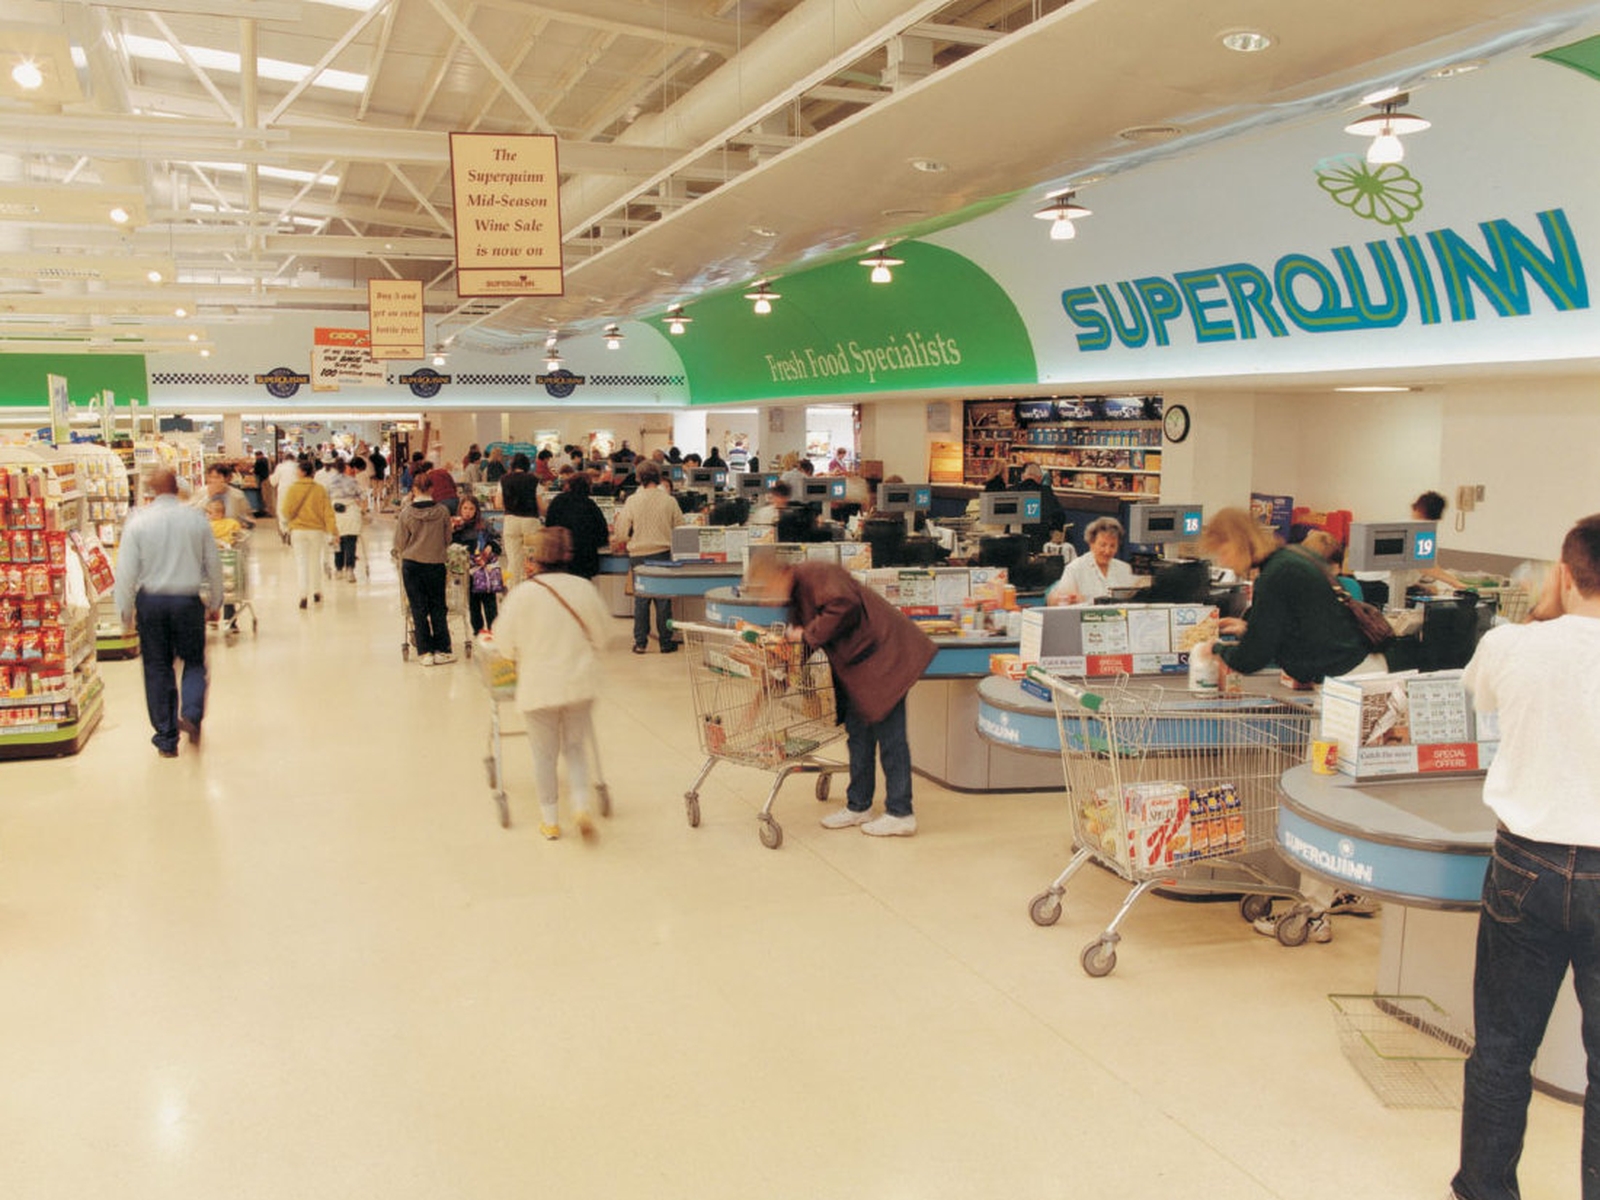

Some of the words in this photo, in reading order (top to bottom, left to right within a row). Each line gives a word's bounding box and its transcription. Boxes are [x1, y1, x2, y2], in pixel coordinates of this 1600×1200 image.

[493, 149, 517, 161] The
[468, 169, 544, 185] Superquinn
[467, 194, 547, 207] Mid-Season
[475, 219, 509, 232] Wine
[514, 219, 543, 232] Sale
[476, 244, 488, 256] is
[492, 246, 521, 256] now
[526, 246, 543, 256] on
[1061, 208, 1590, 351] SUPERQUINN
[765, 351, 808, 382] Fresh
[804, 343, 851, 378] Food
[849, 332, 962, 383] Specialists
[1027, 503, 1039, 514] 17
[1185, 518, 1198, 531] 18
[1417, 538, 1432, 555] 19
[1433, 749, 1466, 759] SPECIAL
[1435, 758, 1466, 768] OFFERS
